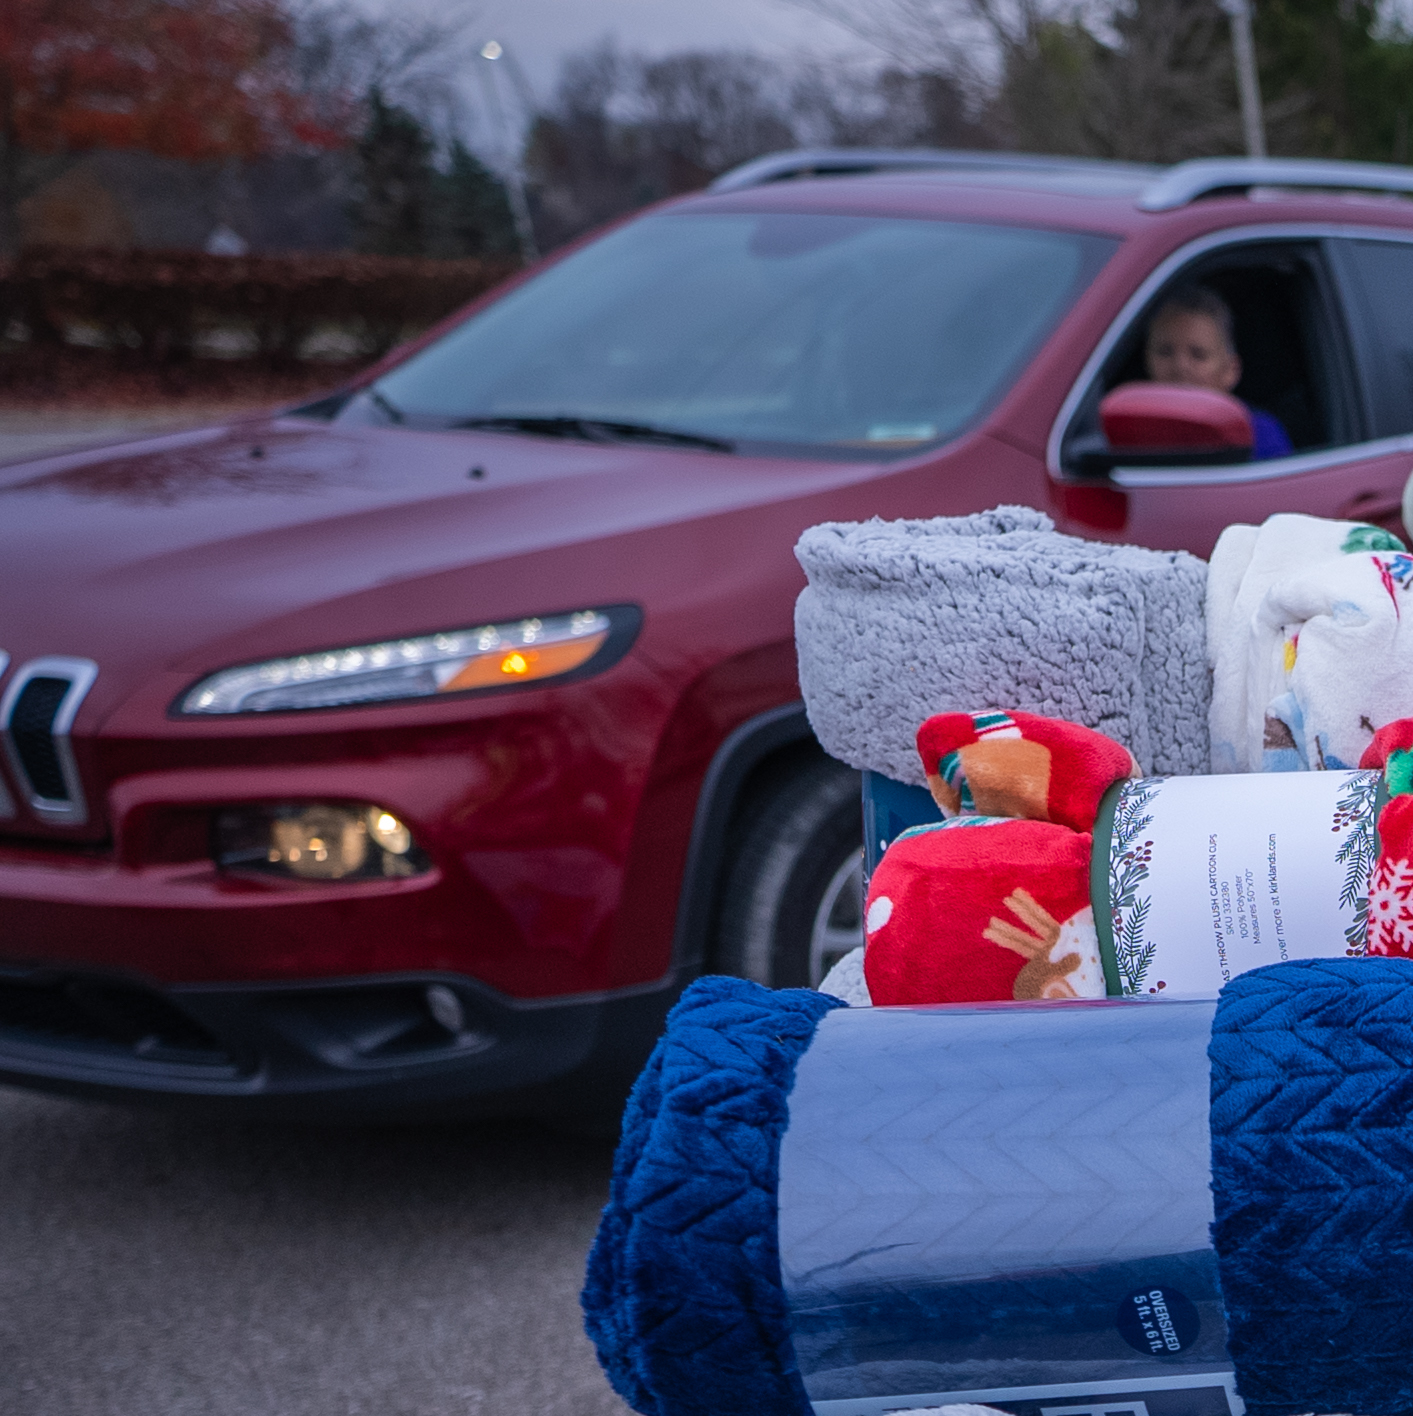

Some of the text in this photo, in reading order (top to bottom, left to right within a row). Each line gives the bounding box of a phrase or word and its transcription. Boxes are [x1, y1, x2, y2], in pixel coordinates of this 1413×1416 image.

[1209, 854, 1217, 896] CARTOON
[1268, 833, 1277, 894] kirklands.com
[1211, 898, 1221, 928] PLUSH
[1235, 874, 1248, 938] 100% Polyester
[1271, 896, 1279, 905] at
[1225, 916, 1233, 935] SKU
[1250, 904, 1260, 944] Measures
[1274, 909, 1284, 934] more
[1215, 931, 1227, 967] THROW
[1133, 1295, 1163, 1352] 5 ft. x 6 ft.
[1148, 1290, 1180, 1351] OVERSIZED
